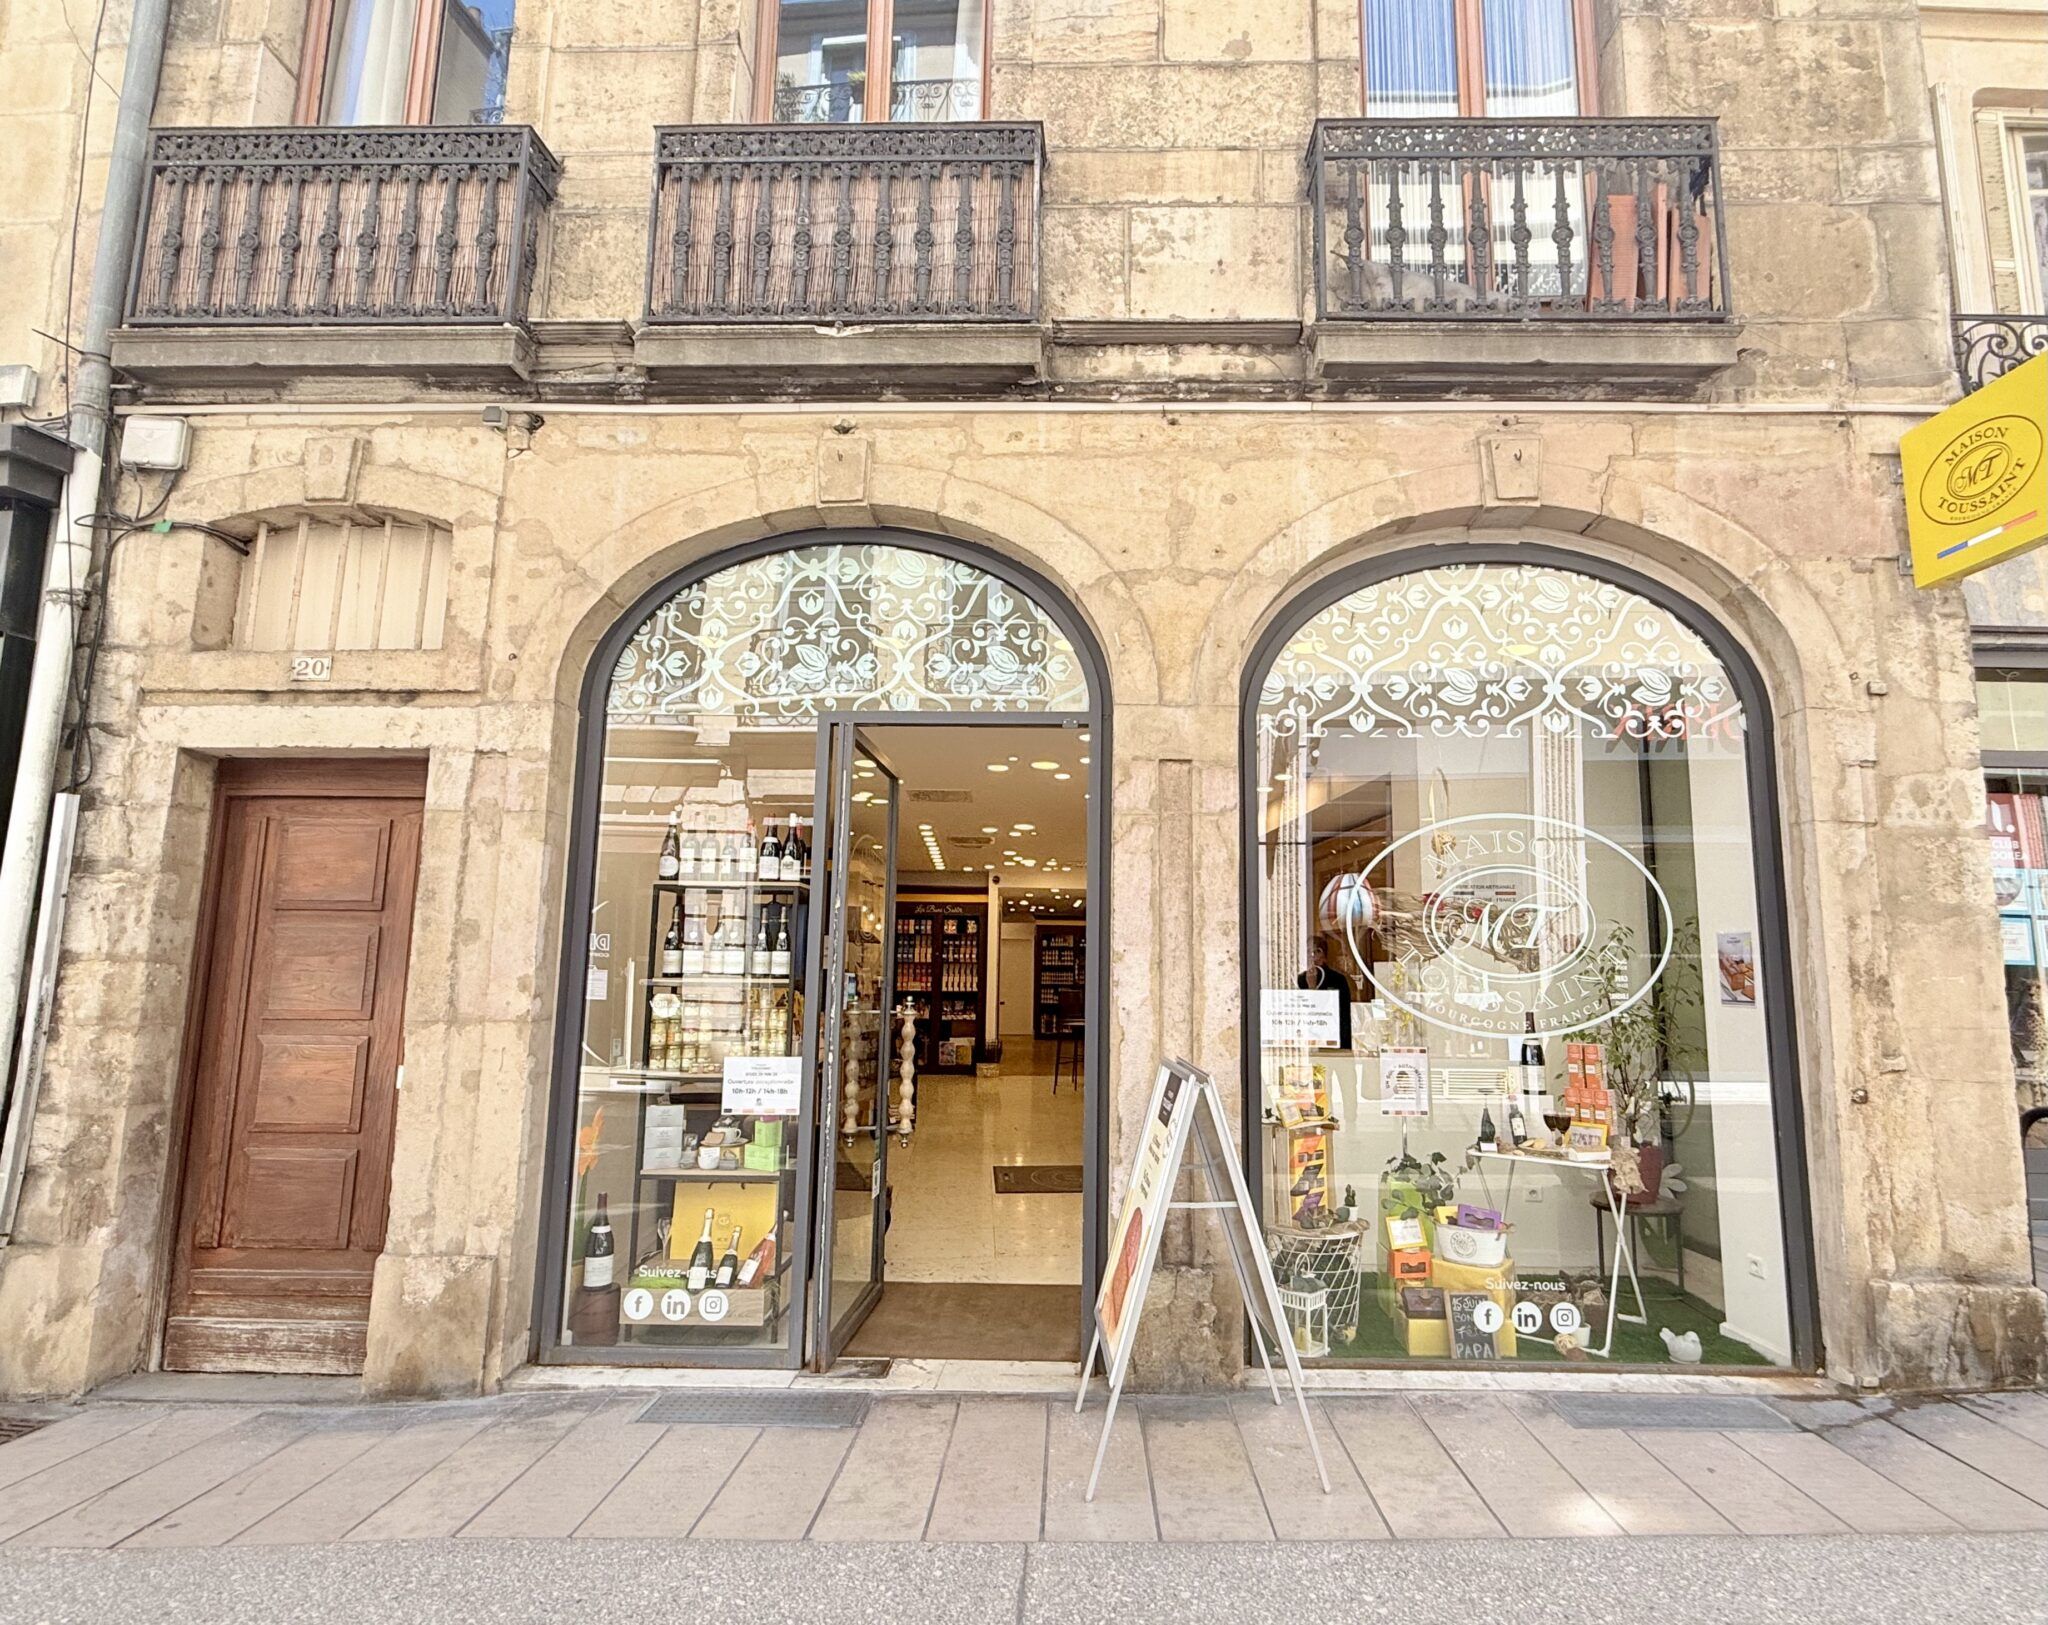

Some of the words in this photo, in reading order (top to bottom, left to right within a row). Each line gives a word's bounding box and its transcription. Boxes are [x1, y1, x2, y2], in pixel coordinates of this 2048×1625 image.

[1944, 426, 2009, 467] MAISON
[1937, 457, 2026, 515] TOUSSAINT
[296, 659, 325, 677] 20
[1422, 829, 1592, 876] MAISON
[1424, 1000, 1533, 1032] OURGOGNE
[1539, 1000, 1605, 1031] FRANCE
[638, 1264, 718, 1279] Suivez-nus
[1485, 1277, 1567, 1292] Suivez-nous
[1456, 1342, 1494, 1359] PAPA
